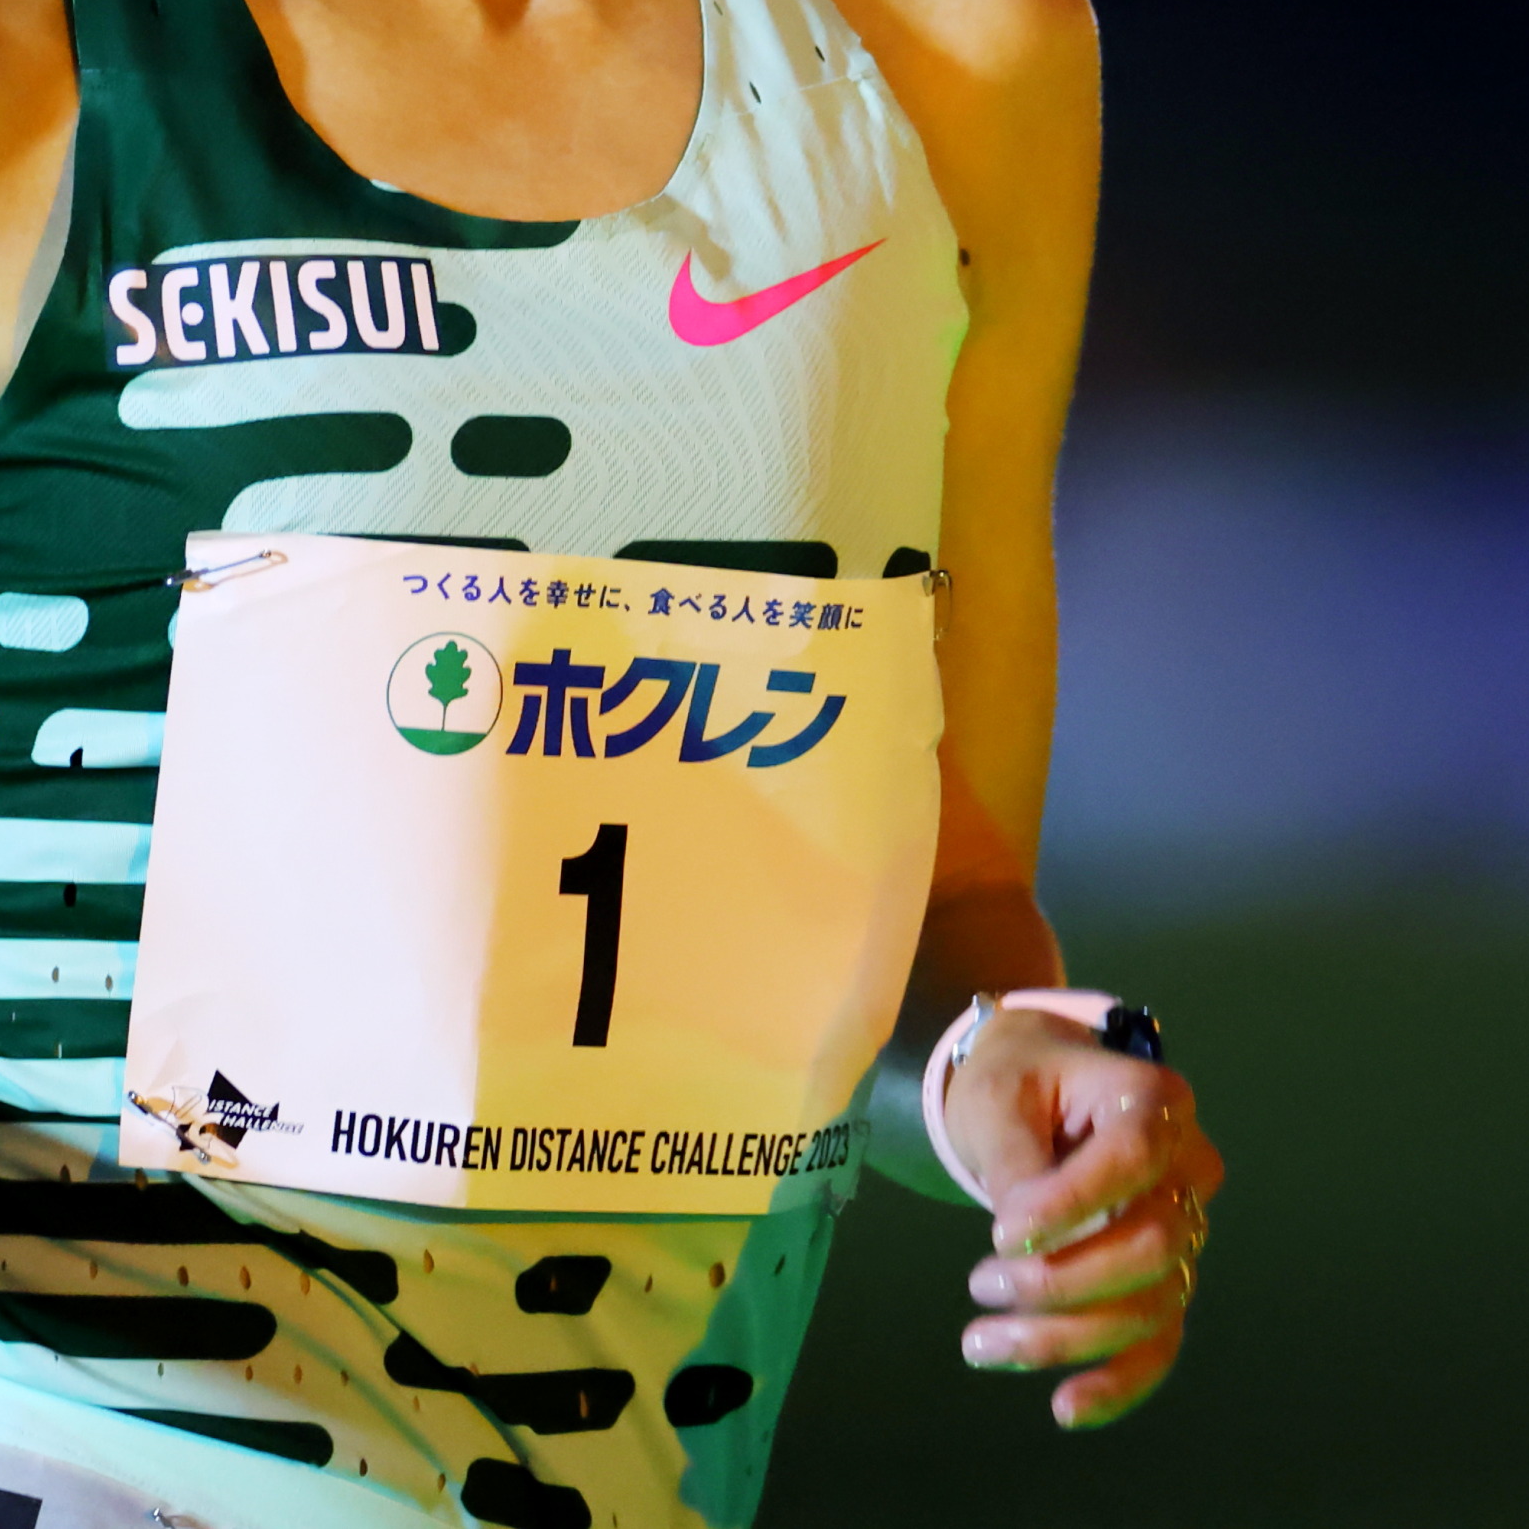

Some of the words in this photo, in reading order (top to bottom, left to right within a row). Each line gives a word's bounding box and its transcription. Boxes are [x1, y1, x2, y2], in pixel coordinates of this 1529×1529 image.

[109, 259, 439, 365] SEKISUI
[402, 572, 864, 630] つくる人を幸せに、食べる人を笑顔に
[506, 648, 847, 768] ホクレン
[559, 823, 628, 1047] 1
[331, 1109, 502, 1170] HOKUREN
[510, 1127, 645, 1173] DISTANCE
[651, 1130, 806, 1176] CHALLENGE
[806, 1122, 850, 1172] 2023
